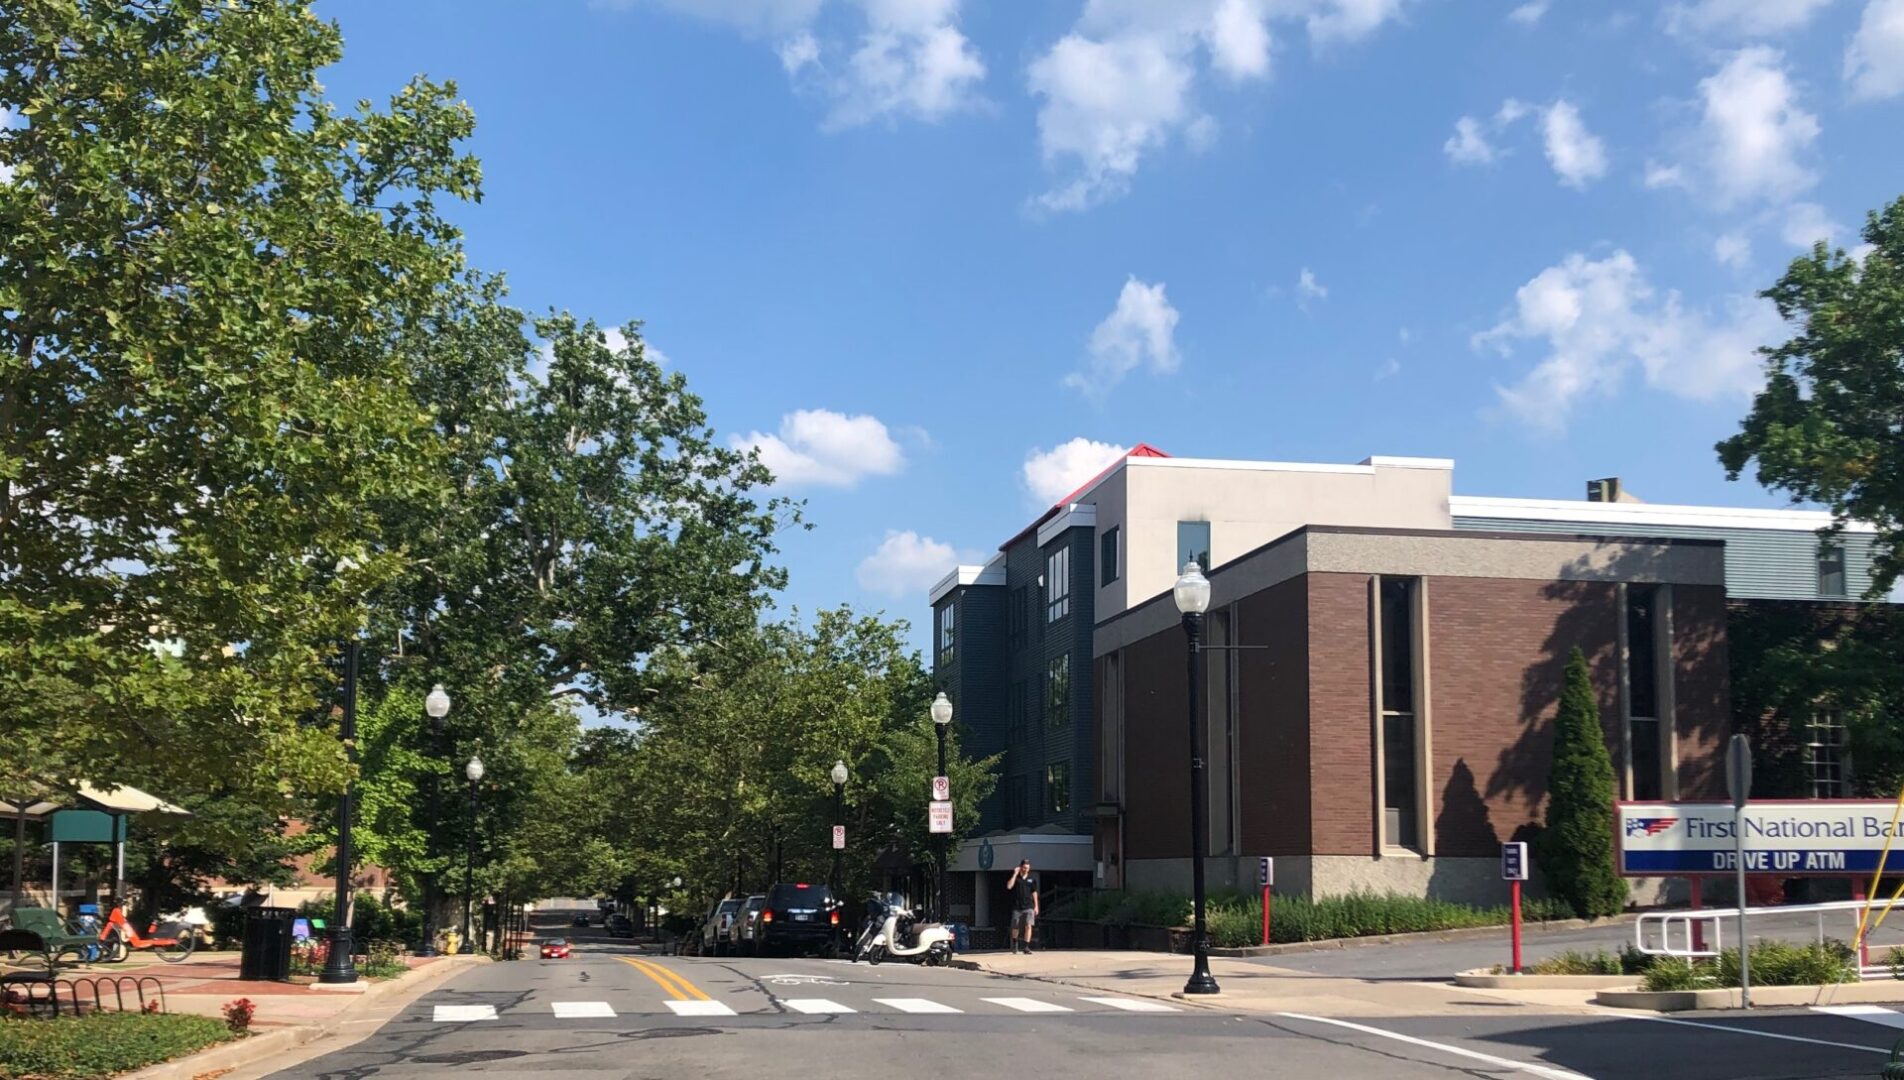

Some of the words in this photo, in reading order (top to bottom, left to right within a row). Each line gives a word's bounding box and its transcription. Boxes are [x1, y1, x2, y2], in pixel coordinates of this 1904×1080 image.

[1686, 817, 1737, 838] First
[1744, 817, 1855, 838] National
[1713, 852, 1769, 870] DRVE
[1774, 852, 1800, 870] UP
[1806, 852, 1845, 870] ATM
